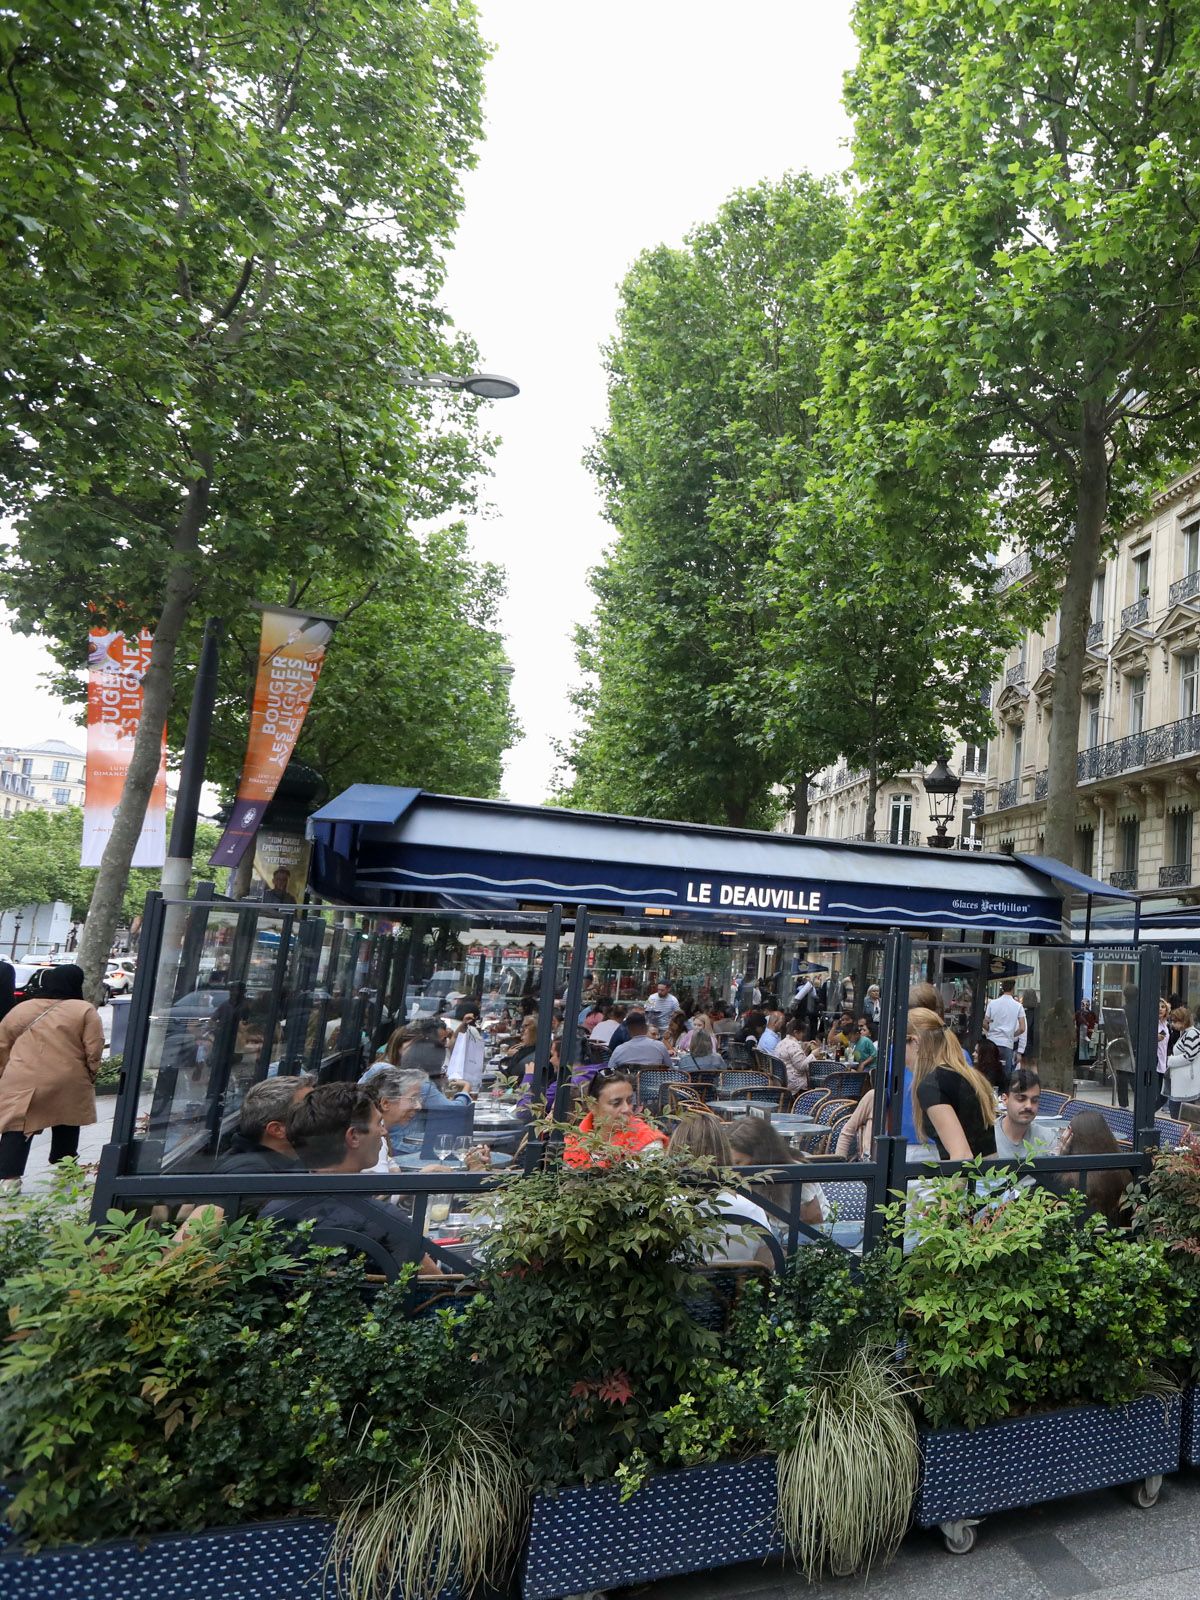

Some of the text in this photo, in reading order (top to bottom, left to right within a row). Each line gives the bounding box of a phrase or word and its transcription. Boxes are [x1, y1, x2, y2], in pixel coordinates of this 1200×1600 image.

[262, 656, 288, 735] BOUGER
[268, 731, 287, 763] LES
[278, 658, 303, 726] LIGNES
[687, 882, 821, 911] LE DEAUVILLE
